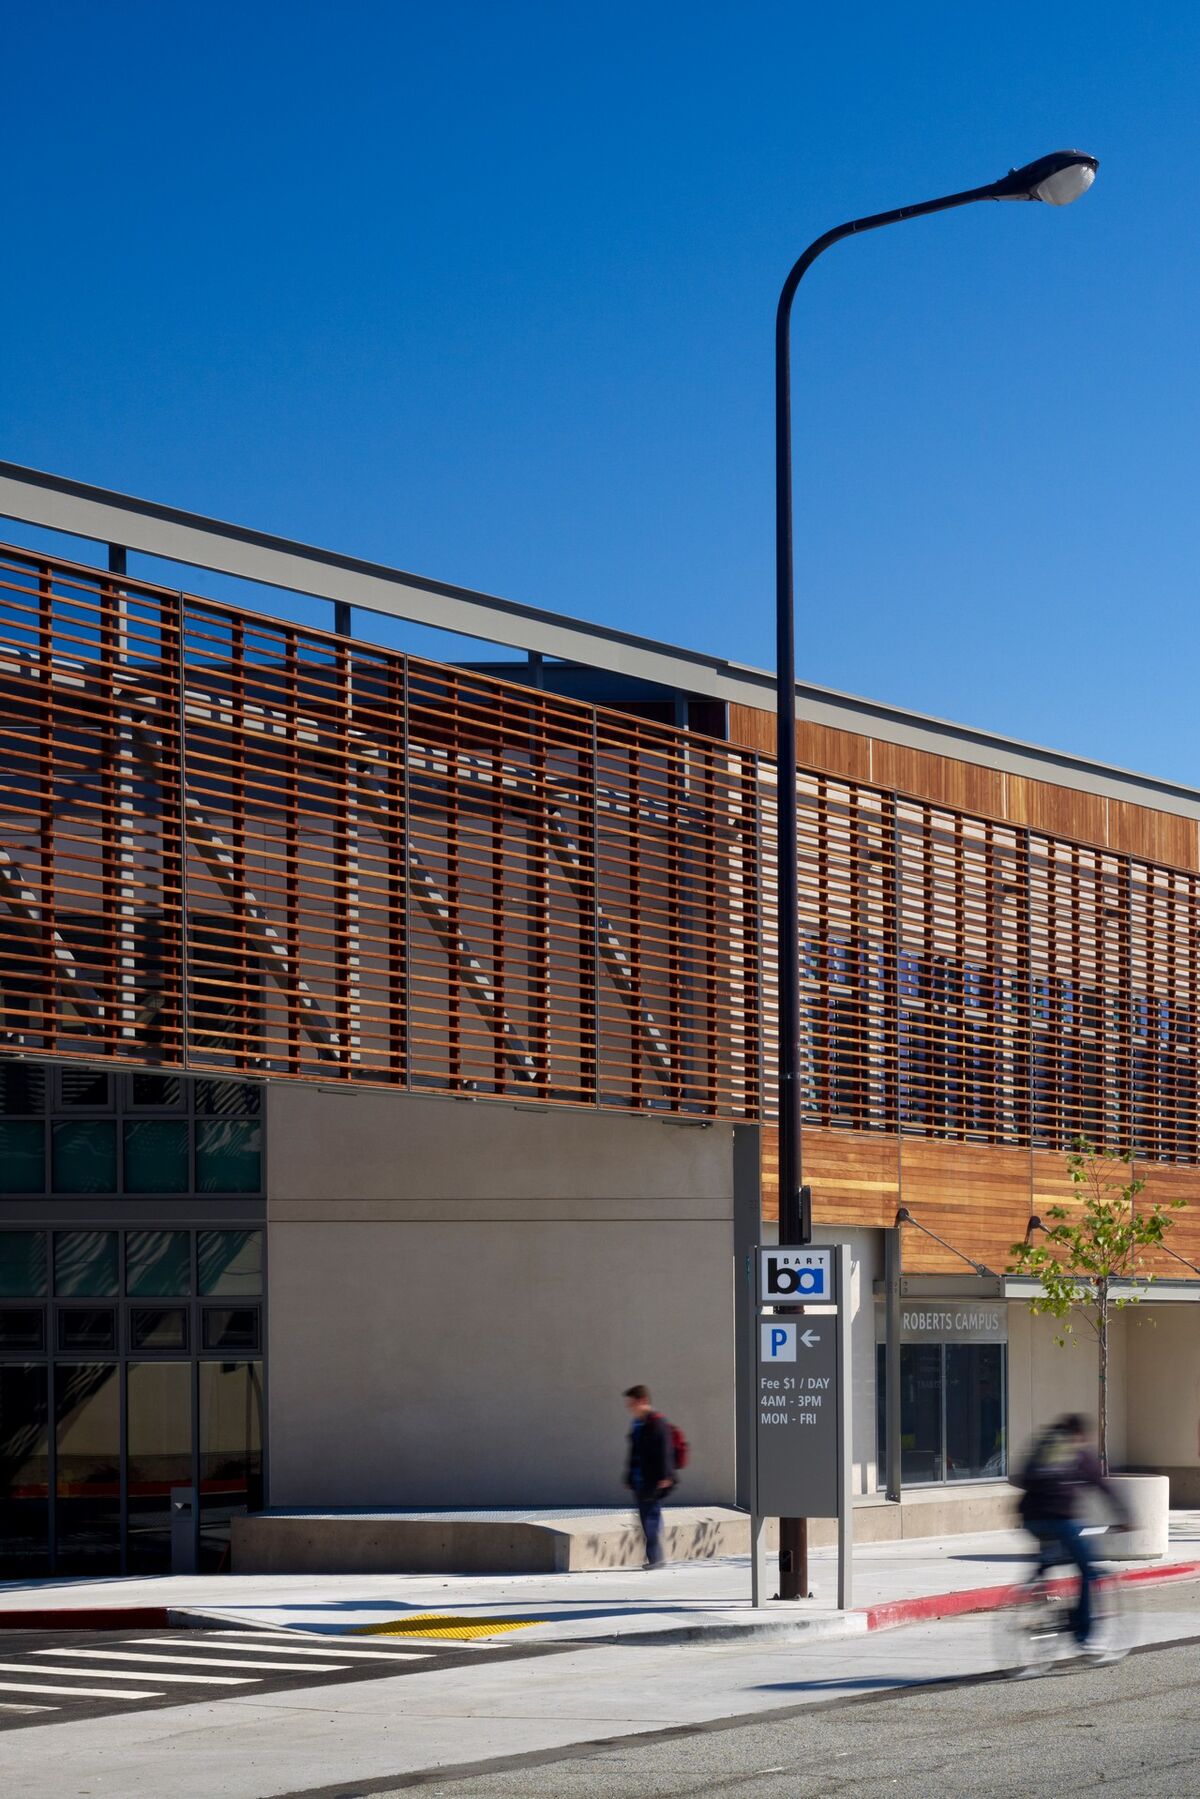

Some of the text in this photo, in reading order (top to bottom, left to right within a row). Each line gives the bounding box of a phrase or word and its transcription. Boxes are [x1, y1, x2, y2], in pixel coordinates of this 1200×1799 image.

[783, 1257, 824, 1265] BART
[903, 1312, 999, 1330] ROBERTS CAMPUS
[771, 1328, 787, 1357] P
[761, 1377, 780, 1389] Fee
[783, 1377, 796, 1390] $1
[807, 1377, 830, 1389] DAY
[760, 1395, 786, 1407] 4AM
[797, 1395, 822, 1407] 3PM
[761, 1412, 789, 1425] MON
[800, 1412, 817, 1425] FRI
